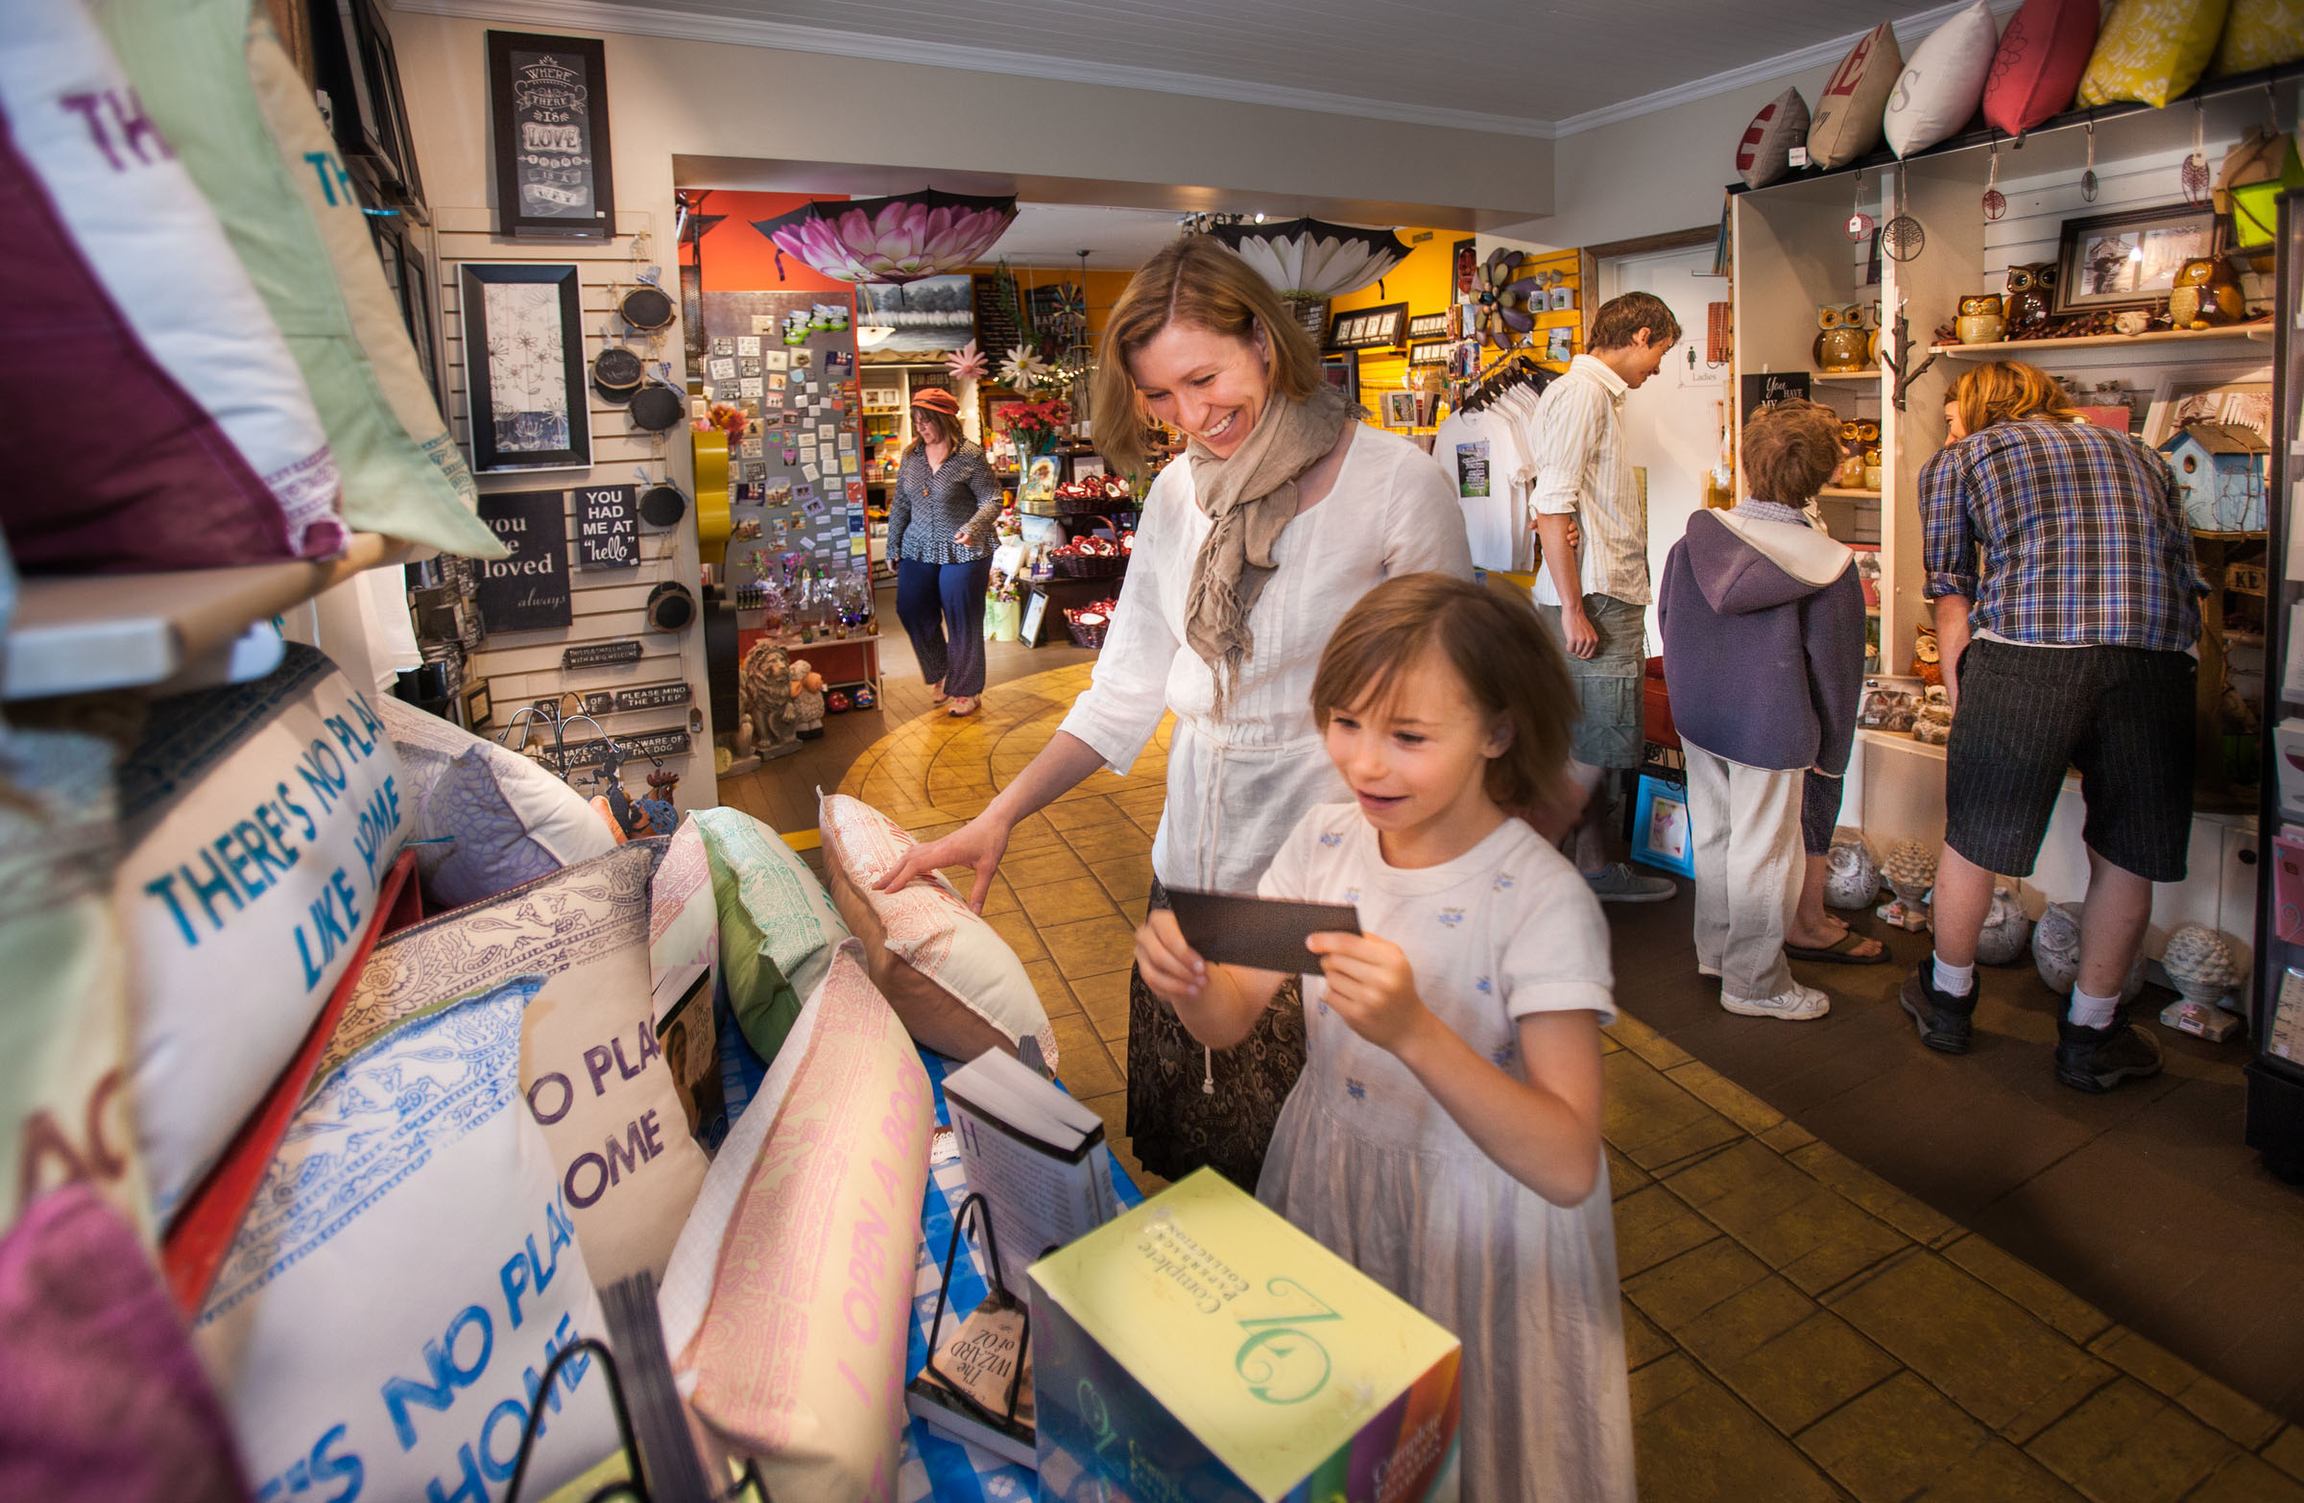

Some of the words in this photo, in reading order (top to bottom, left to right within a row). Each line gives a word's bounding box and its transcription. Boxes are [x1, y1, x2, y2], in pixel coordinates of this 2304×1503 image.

[526, 68, 572, 82] WHERE
[533, 95, 567, 106] THERE
[544, 112, 559, 122] IS
[529, 127, 576, 147] LOVE
[1340, 316, 1396, 339] HOPE
[1692, 372, 1717, 382] Ladies
[1766, 376, 1786, 399] You
[1783, 389, 1804, 398] HAVE
[586, 490, 622, 505] YOU
[588, 505, 624, 519] HAD
[583, 522, 608, 536] ME
[612, 520, 633, 533] AT
[484, 552, 554, 578] loved
[518, 586, 566, 610] always
[622, 688, 659, 700] PLEASE
[662, 687, 686, 695] MIND
[628, 698, 648, 707] THE
[655, 695, 681, 704] STEP
[671, 735, 684, 743] OF
[654, 745, 673, 754] DOG
[144, 781, 317, 947] THERE'S
[296, 738, 346, 816] NO
[323, 690, 386, 764] PLA
[293, 866, 361, 993] LIKE
[353, 775, 401, 890] HOME
[527, 1072, 574, 1126] O
[564, 1108, 665, 1209] OME
[843, 1197, 890, 1347] OPEN
[870, 1157, 901, 1209] A
[1138, 1242, 1221, 1315] Complete
[972, 1329, 998, 1347] OZ
[999, 1338, 1015, 1351] of
[950, 1340, 1012, 1378] WIZARD
[381, 1304, 494, 1454] NO
[957, 1362, 982, 1387] The
